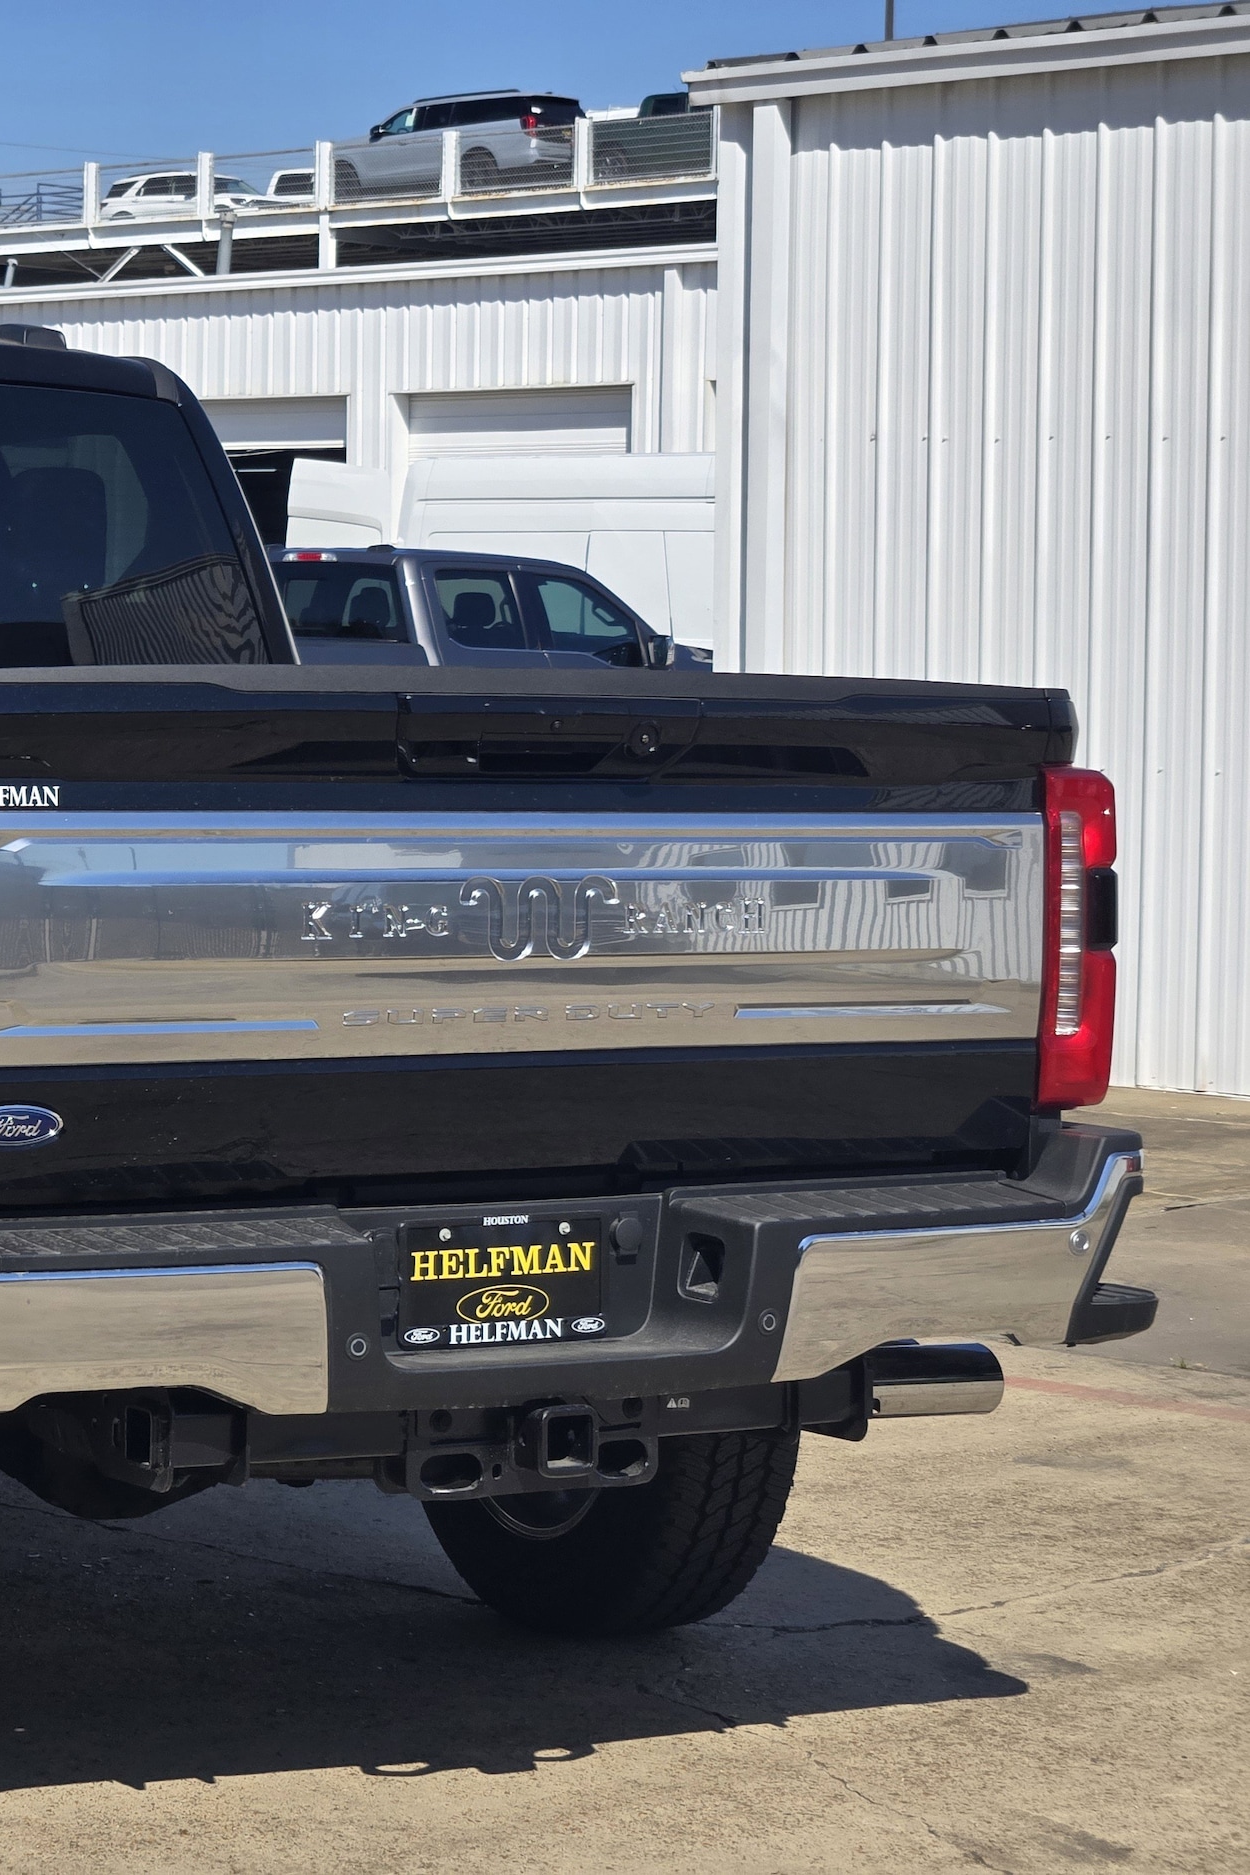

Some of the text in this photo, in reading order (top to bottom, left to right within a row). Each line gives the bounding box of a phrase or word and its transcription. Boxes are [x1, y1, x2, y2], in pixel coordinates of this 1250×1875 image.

[300, 897, 767, 941] KING RANCH
[343, 1002, 716, 1026] SUPER DUTY
[482, 1214, 529, 1227] HOUSTON
[410, 1241, 596, 1281] HELFMAN
[475, 1290, 533, 1319] Ford
[409, 1317, 603, 1345] Ford HELFMAN Ford
